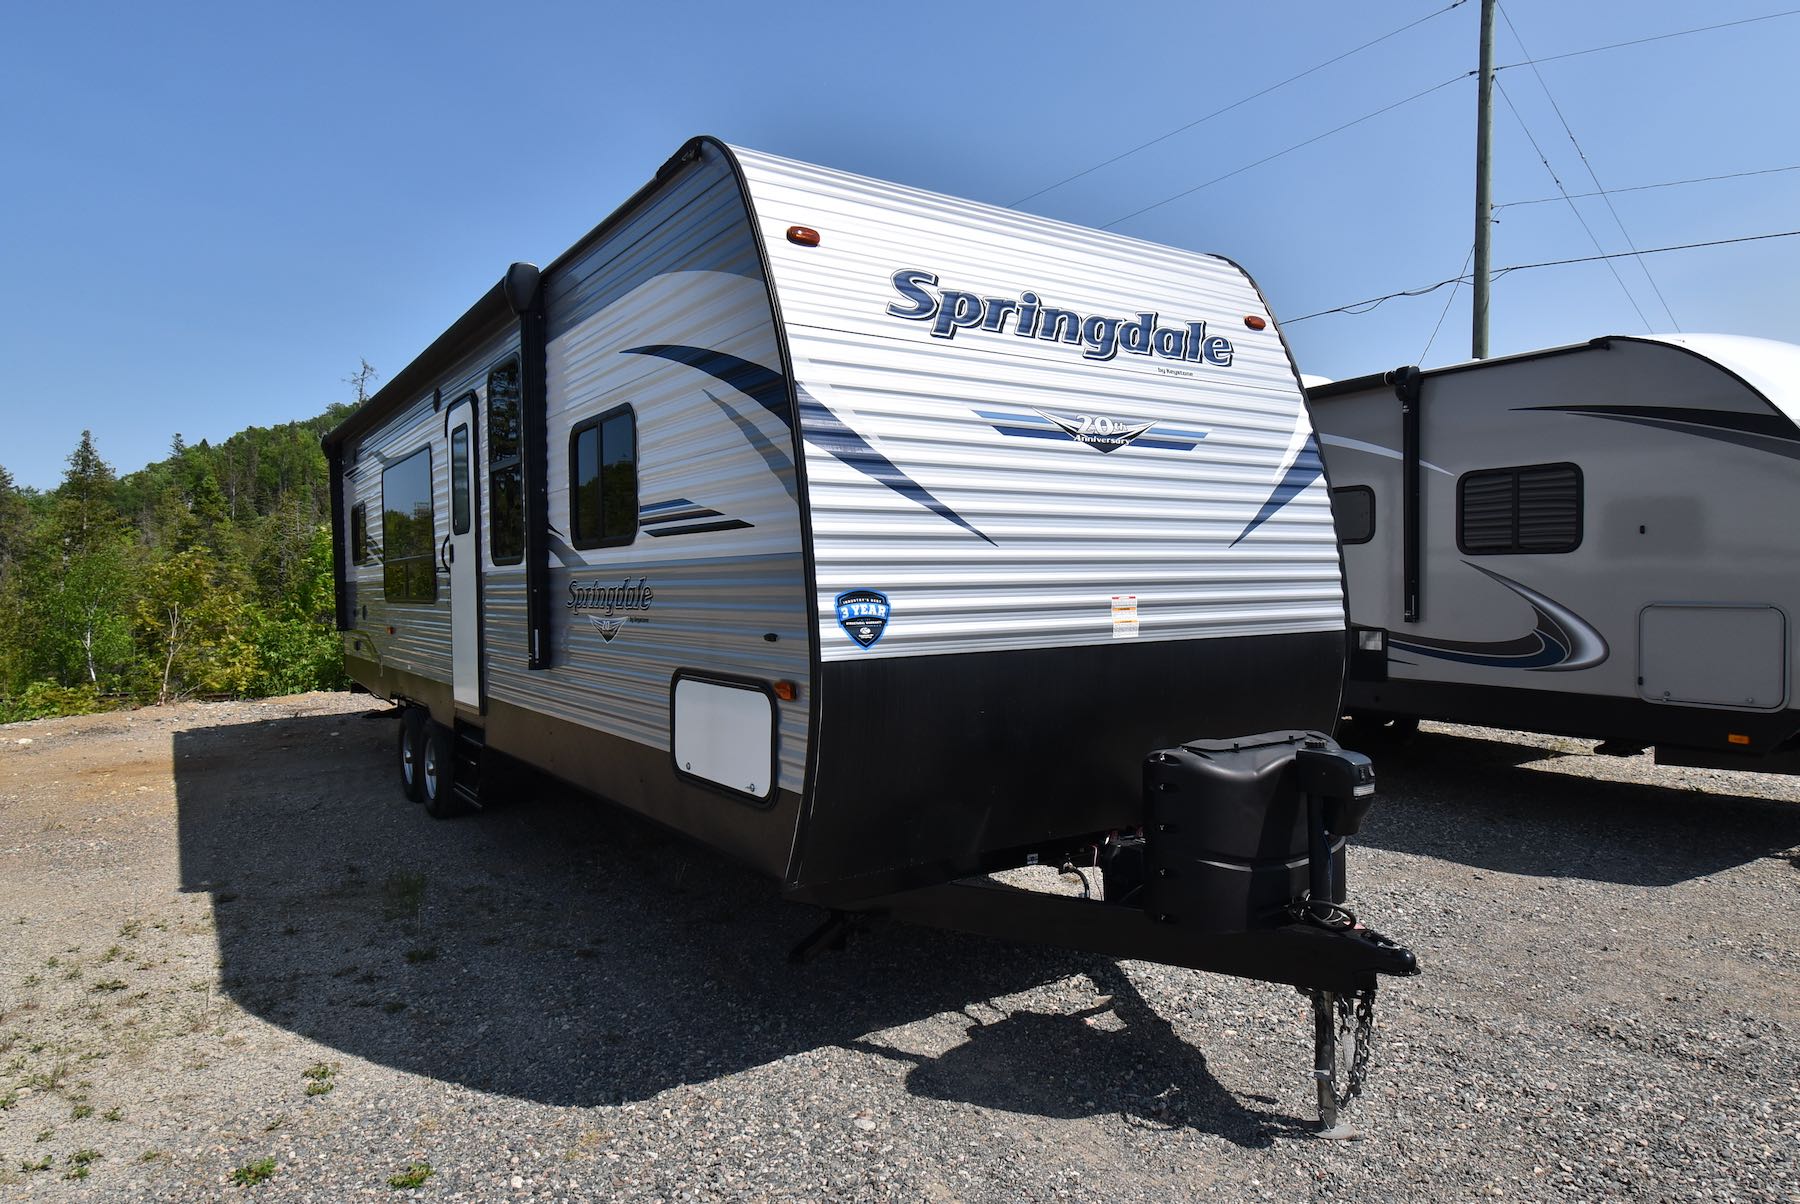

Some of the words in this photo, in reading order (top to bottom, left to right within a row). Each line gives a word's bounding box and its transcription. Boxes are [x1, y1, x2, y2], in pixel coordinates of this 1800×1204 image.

[886, 268, 1235, 367] Springdale
[1076, 414, 1128, 435] 20th
[1074, 434, 1131, 446] Anniversary
[566, 576, 653, 616] Springdale
[840, 607, 849, 619] 3
[850, 604, 886, 617] YEAR
